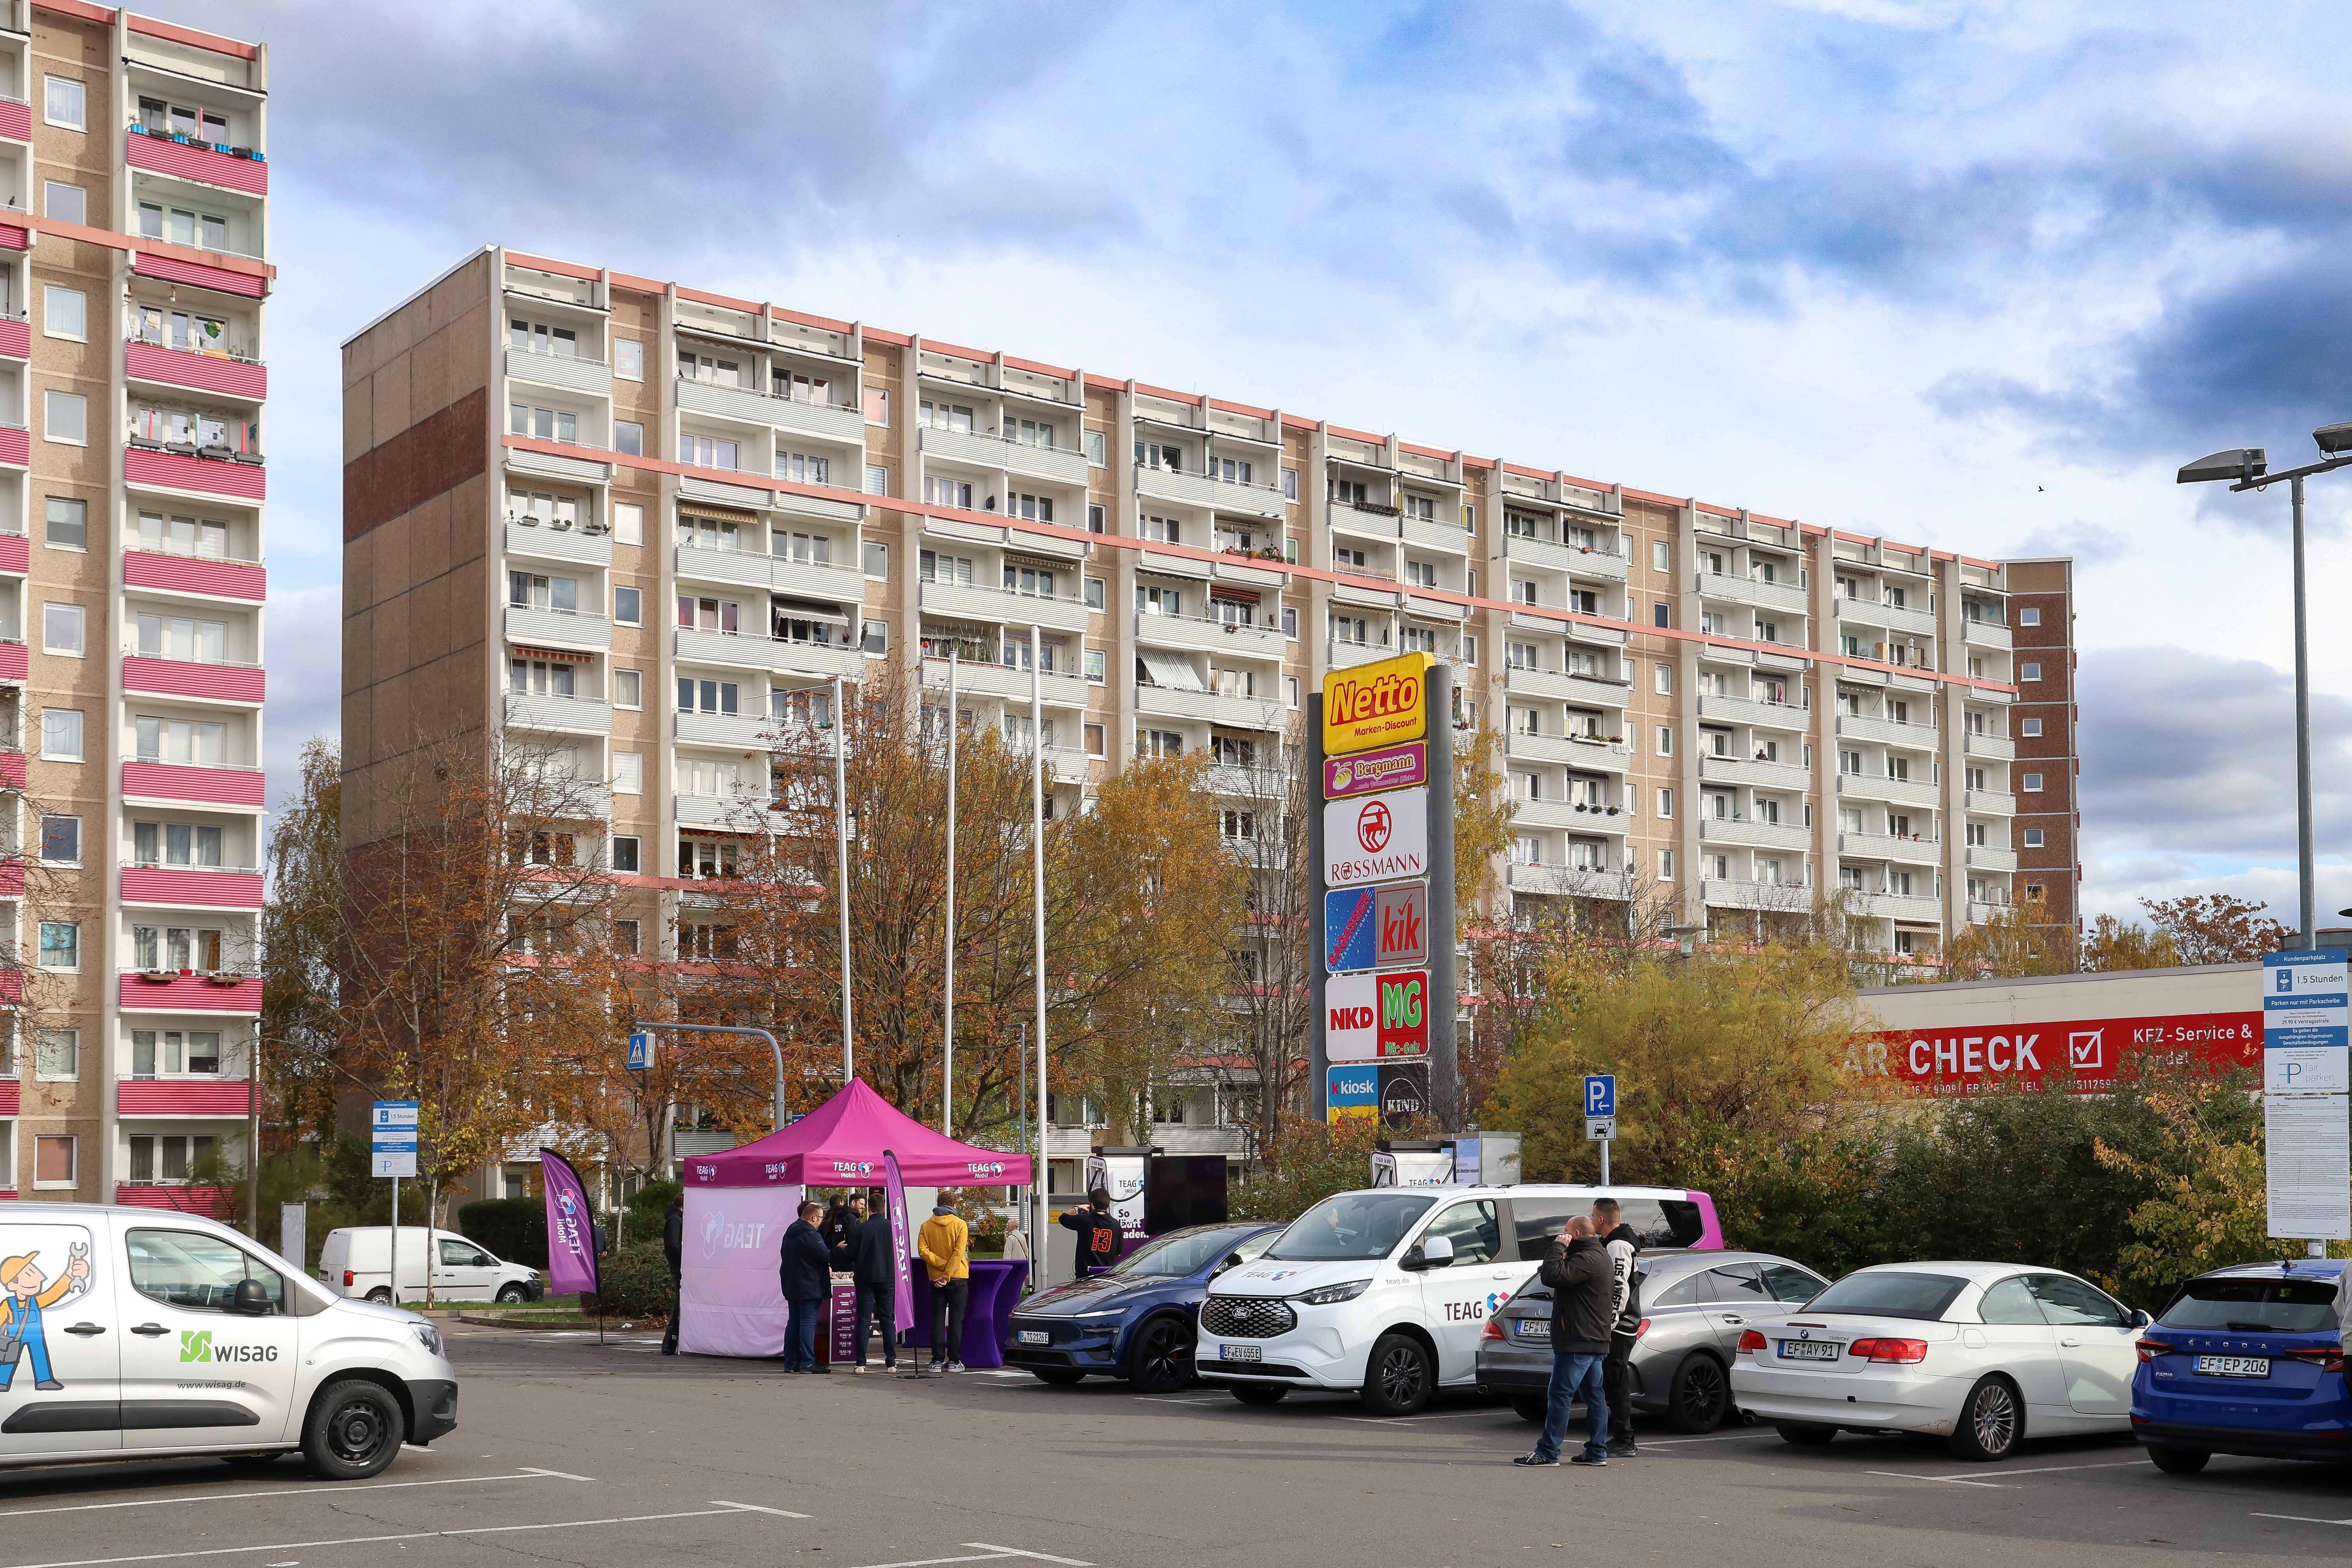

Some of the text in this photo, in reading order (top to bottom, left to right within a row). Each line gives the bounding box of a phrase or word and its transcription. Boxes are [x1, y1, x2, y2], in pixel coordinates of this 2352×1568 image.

[1330, 674, 1418, 726] Netto
[1354, 717, 1417, 737] Marken-Discount
[1356, 756, 1414, 778] Bergmann
[1399, 774, 1416, 784] Bäcker
[1332, 852, 1419, 881] ROSSMANN
[1328, 892, 1371, 966] SAGASSER
[1382, 894, 1421, 953] kik
[2310, 975, 2343, 983] Stunden
[1383, 980, 1422, 1029] MG
[1330, 1006, 1374, 1031] NKD
[2241, 1024, 2252, 1038] &
[1385, 1041, 1420, 1055] Mäc-Geiz
[1843, 1034, 2041, 1076] AR CHECK
[2305, 1063, 2319, 1072] fair
[2306, 1073, 2334, 1083] parken
[1341, 1080, 1374, 1094] kiosk
[1590, 1082, 1605, 1111] P
[1387, 1099, 1419, 1112] KIND
[697, 1166, 708, 1174] TEAG
[766, 1163, 778, 1173] TEAG
[833, 1162, 857, 1172] TEAG
[967, 1163, 989, 1172] TEAG
[1118, 1209, 1130, 1218] So
[1092, 1227, 1112, 1252] 13
[1123, 1229, 1149, 1239] aden.
[1614, 1257, 1625, 1277] LOS
[1386, 1277, 1410, 1286] teag.de
[1235, 1308, 1249, 1317] Ford
[1445, 1301, 1482, 1321] TEAG
[1523, 1321, 1535, 1332] EF
[1541, 1322, 1550, 1332] VA
[1021, 1332, 1024, 1341] B
[1224, 1347, 1232, 1356] EF
[1235, 1347, 1243, 1357] EV
[1788, 1343, 1801, 1354] EF
[1806, 1344, 1820, 1356] AY
[1822, 1345, 1833, 1356] 91
[2200, 1357, 2216, 1370] EF
[2223, 1358, 2241, 1371] EP
[2242, 1359, 2267, 1373] 206
[178, 1381, 246, 1389] www.wisag.de
